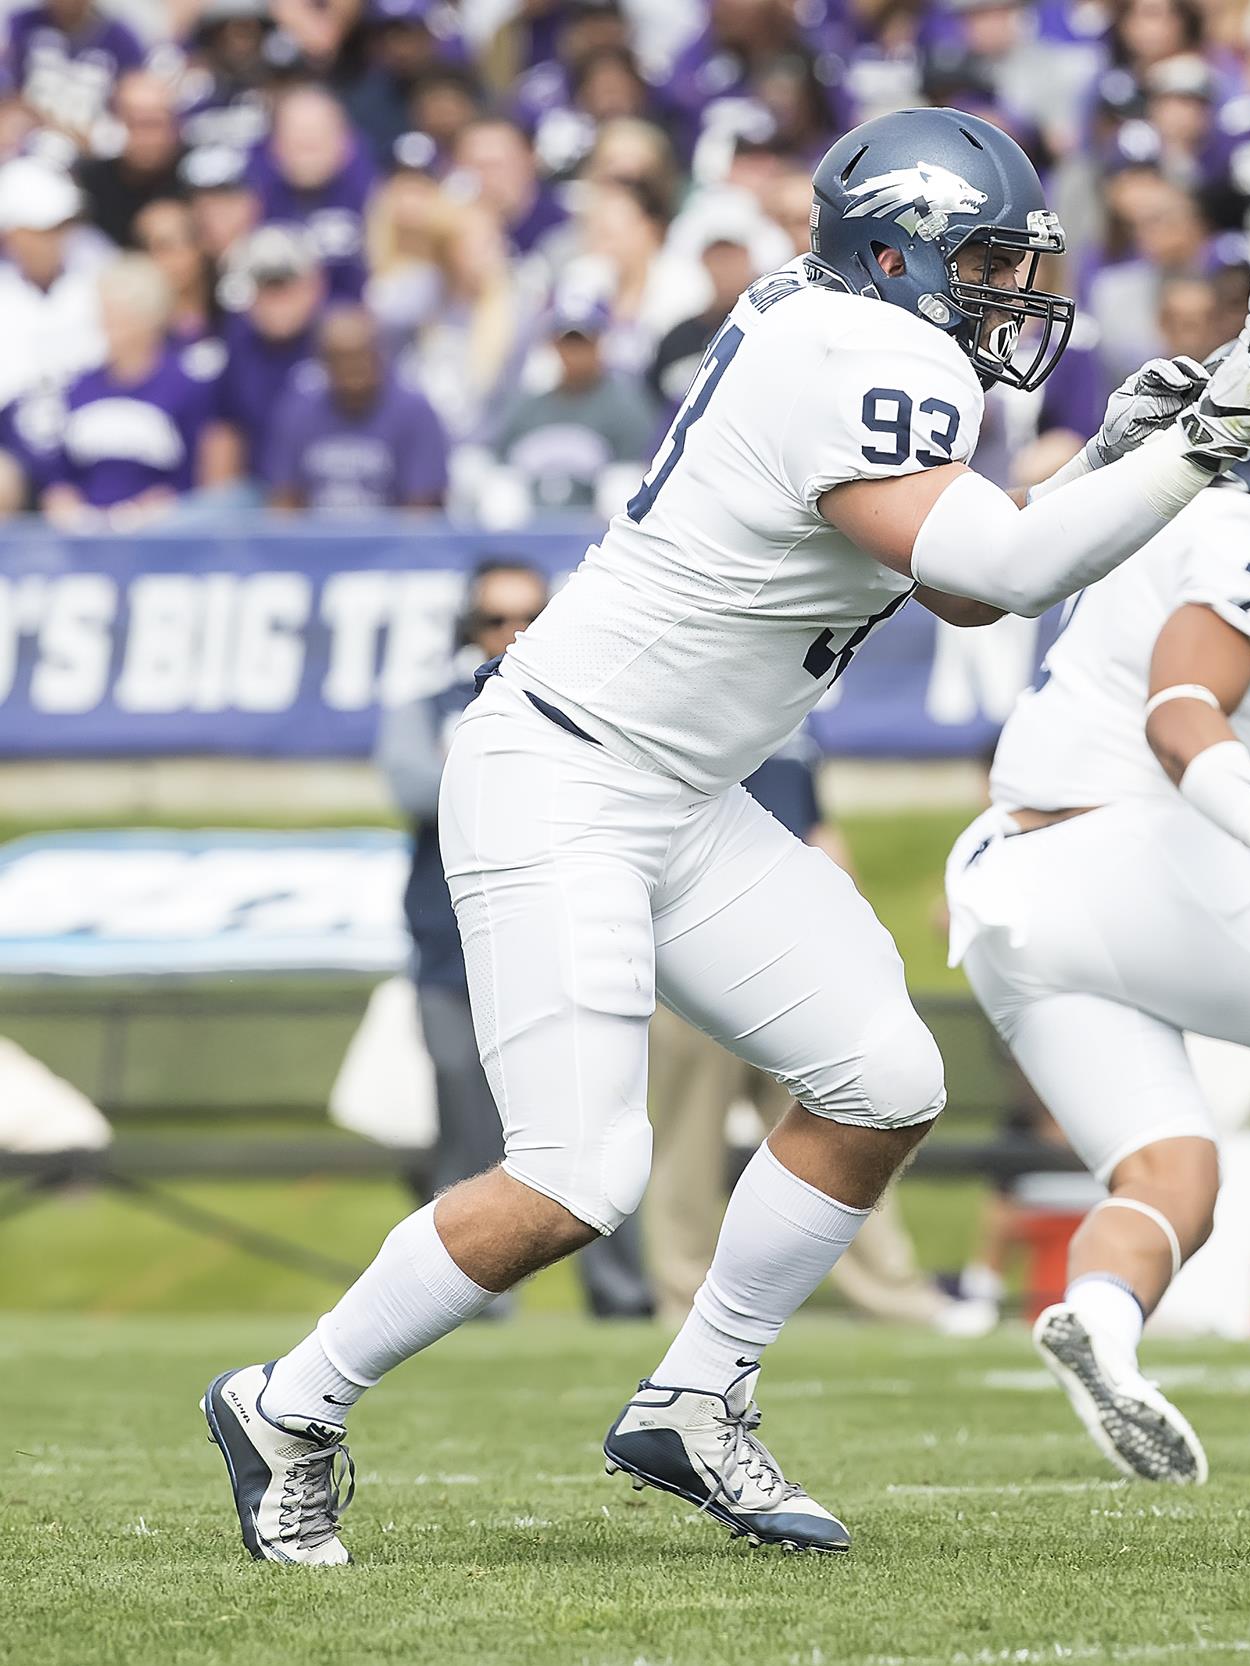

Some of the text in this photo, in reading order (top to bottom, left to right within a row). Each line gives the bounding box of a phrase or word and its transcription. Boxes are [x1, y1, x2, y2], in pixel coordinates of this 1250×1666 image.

[861, 387, 961, 468] 93
[0, 569, 466, 715] 'S BIG TE
